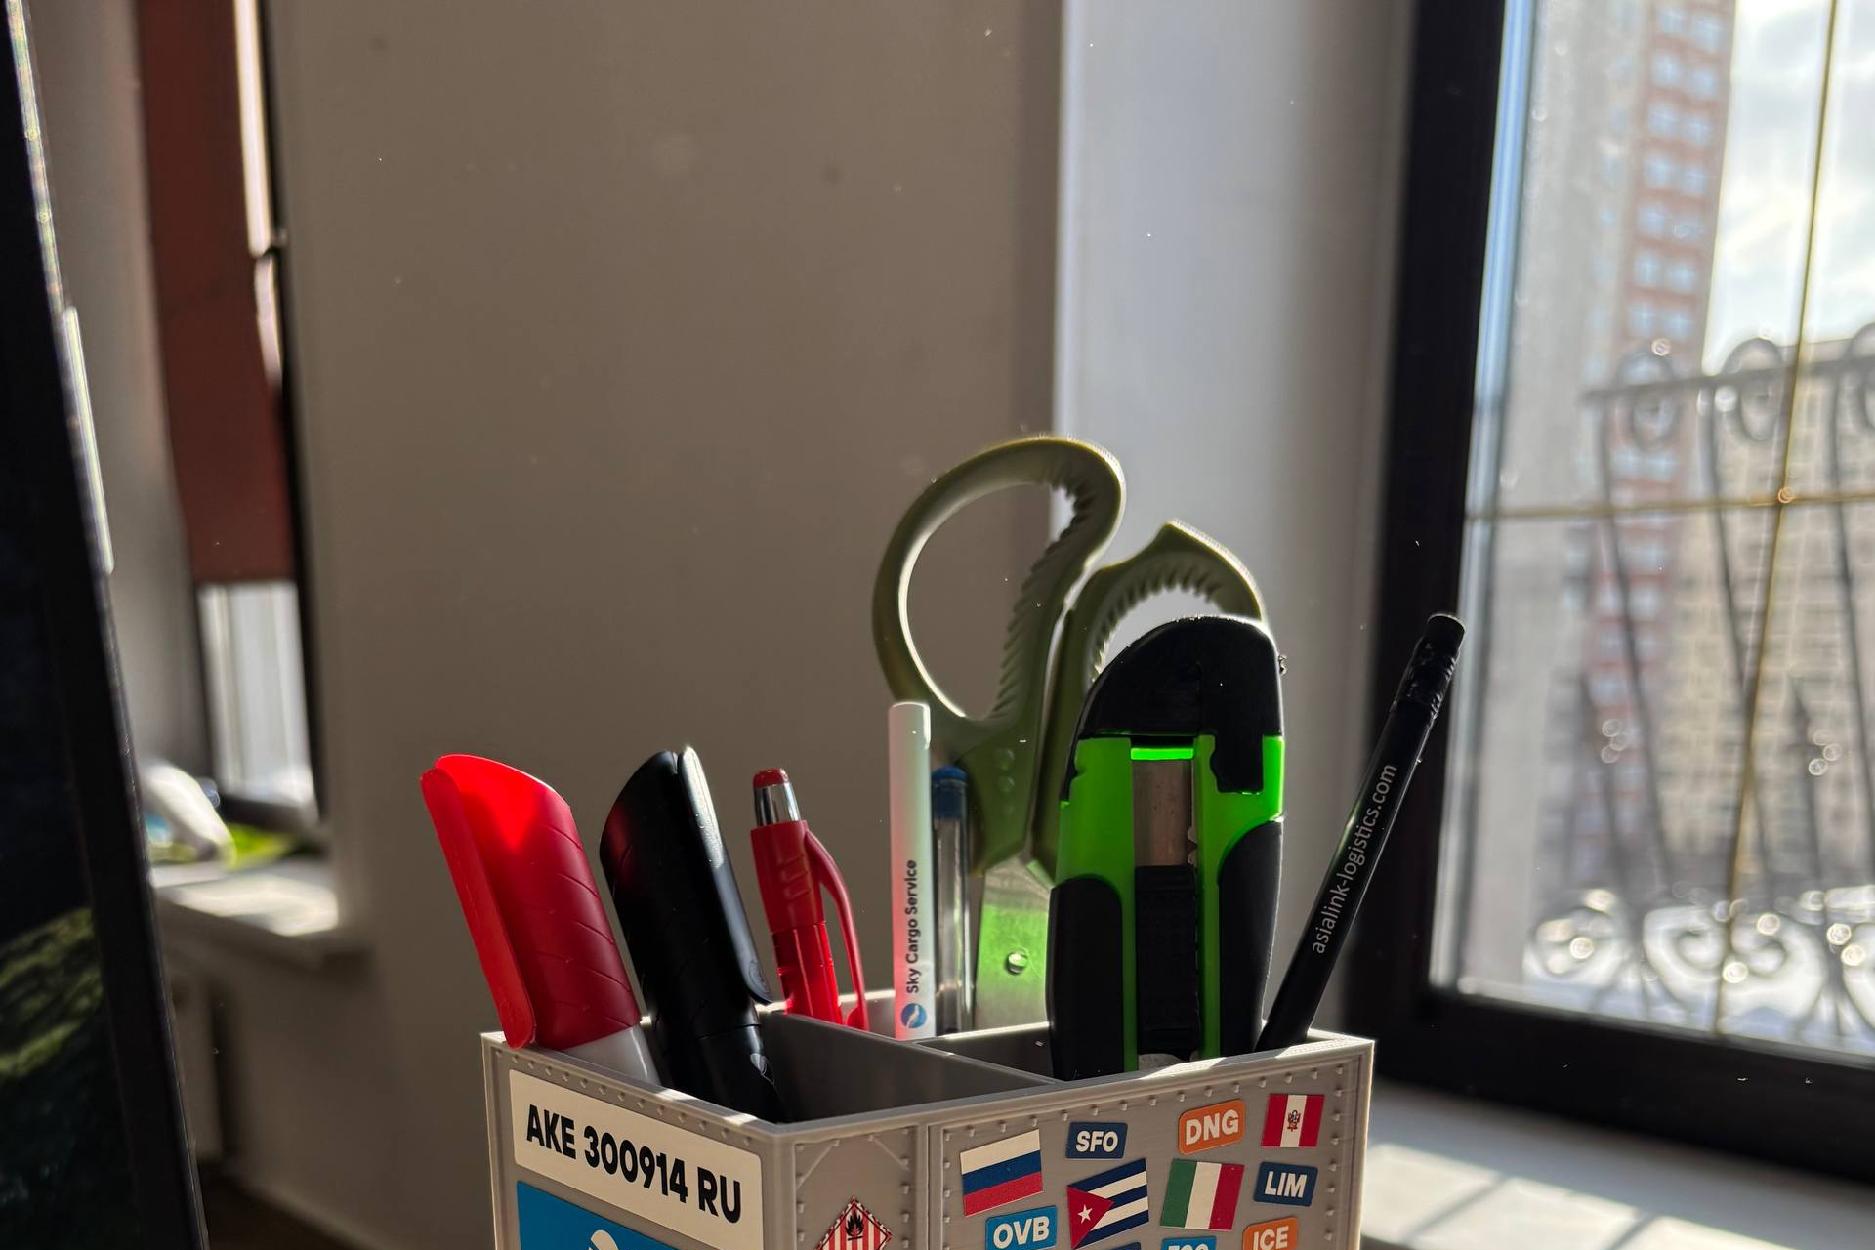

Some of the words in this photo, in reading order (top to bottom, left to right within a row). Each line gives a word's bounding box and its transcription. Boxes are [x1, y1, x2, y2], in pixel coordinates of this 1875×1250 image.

[1312, 764, 1398, 954] asialink-logistics.com
[904, 860, 918, 915] Service
[905, 919, 921, 964] Cargo
[906, 968, 921, 993] Sky
[1075, 1130, 1118, 1153] SFO
[1185, 1109, 1239, 1146] DNG
[525, 1103, 577, 1160] AKE
[583, 1125, 689, 1204] 300914
[696, 1166, 741, 1224] RU
[1265, 1171, 1308, 1199] LIM
[992, 1216, 1050, 1249] OVB
